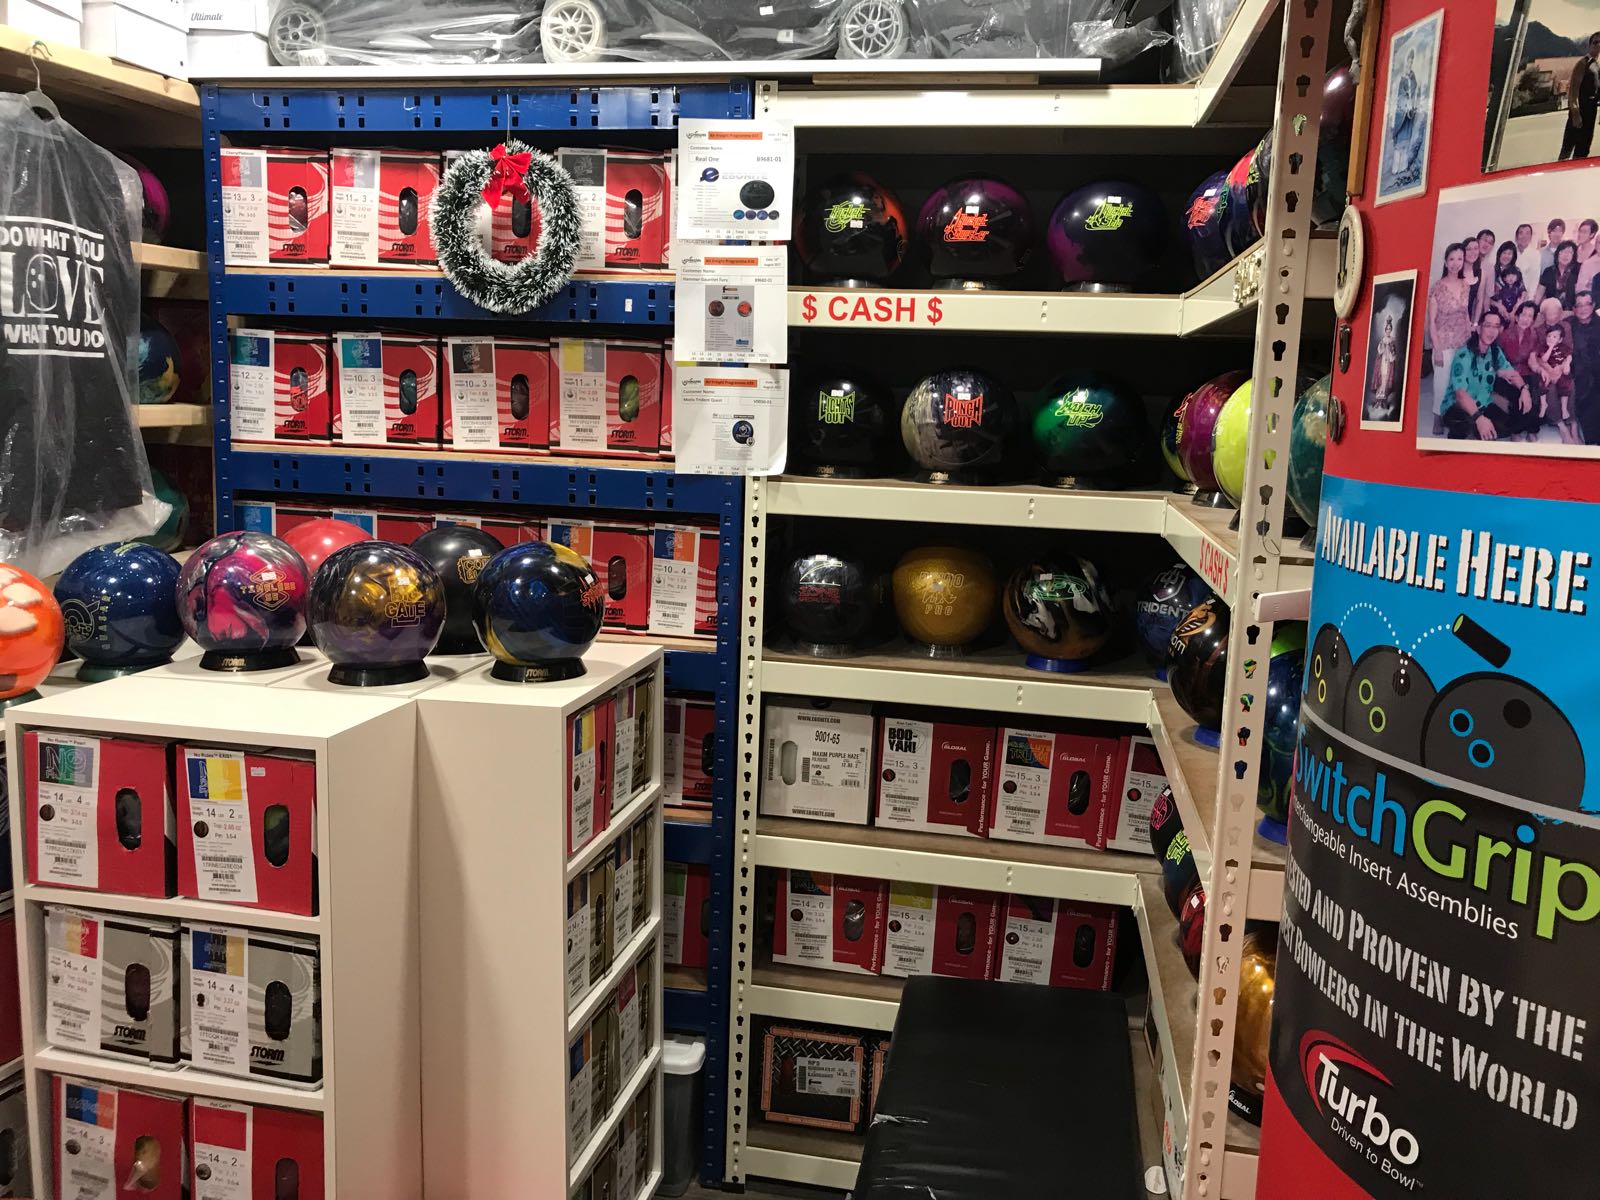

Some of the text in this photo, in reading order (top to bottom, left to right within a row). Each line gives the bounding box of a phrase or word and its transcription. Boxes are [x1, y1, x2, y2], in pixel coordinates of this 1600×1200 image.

[233, 193, 242, 202] 13
[345, 193, 353, 202] 11
[0, 226, 105, 262] DO WHAT YOU
[282, 243, 305, 254] STORM
[392, 243, 415, 254] STORM
[504, 245, 528, 255] STORM
[615, 247, 640, 257] STORM
[0, 251, 106, 325] LOVE
[828, 295, 916, 322] CASH
[4, 323, 105, 348] WHAT YOU DO
[354, 374, 363, 382] 10
[465, 379, 474, 388] 10
[283, 420, 306, 429] STORM
[391, 423, 414, 432] STORM
[504, 428, 528, 437] STORM
[611, 430, 635, 439] STORM
[1204, 543, 1224, 588] CASH
[1321, 505, 1592, 614] AVAILABLE HERE
[664, 565, 687, 575] 10 4
[384, 600, 426, 618] GATE
[604, 607, 625, 616] TORM
[1136, 600, 1191, 621] TRIDENT
[526, 668, 551, 678] STORM
[797, 715, 841, 724] WWW.EBONITE.COM
[814, 730, 841, 745] 9001-65
[888, 727, 918, 740] BOO-
[888, 739, 917, 754] YAH!
[941, 741, 967, 752] GLOBAL
[983, 741, 991, 761] Game.
[895, 760, 904, 768] 15
[982, 761, 990, 778] YOUR
[1104, 753, 1112, 773] Game.
[1016, 772, 1041, 782] 15 3
[1101, 774, 1110, 792] YOUR
[1141, 780, 1151, 788] 15
[54, 792, 82, 804] 14 4
[206, 807, 235, 819] 14 2
[978, 793, 986, 833] Performance
[1096, 807, 1105, 848] Performance
[1349, 845, 1392, 886] Insert
[1396, 872, 1519, 940] Assemblies
[801, 900, 824, 910] 14 0
[900, 911, 924, 922] 15 4
[1019, 924, 1043, 934] 15 4
[871, 933, 880, 971] Performance
[62, 959, 88, 973] 14 4
[1312, 888, 1345, 941] AND
[1347, 908, 1451, 1005] PROVEN
[1457, 973, 1505, 1027] BY
[1512, 995, 1587, 1062] THE
[207, 979, 235, 993] 14 4
[113, 1025, 146, 1041] STORM
[1294, 925, 1361, 1019] BOWLERS
[1363, 993, 1389, 1039] IN
[1394, 1010, 1445, 1073] THE
[1451, 1035, 1579, 1131] WORLD
[251, 1045, 285, 1062] STORM
[1318, 1052, 1420, 1165] Turbo
[1330, 1116, 1363, 1155] Driven
[1366, 1146, 1378, 1164] to
[209, 1153, 237, 1167] 14 2
